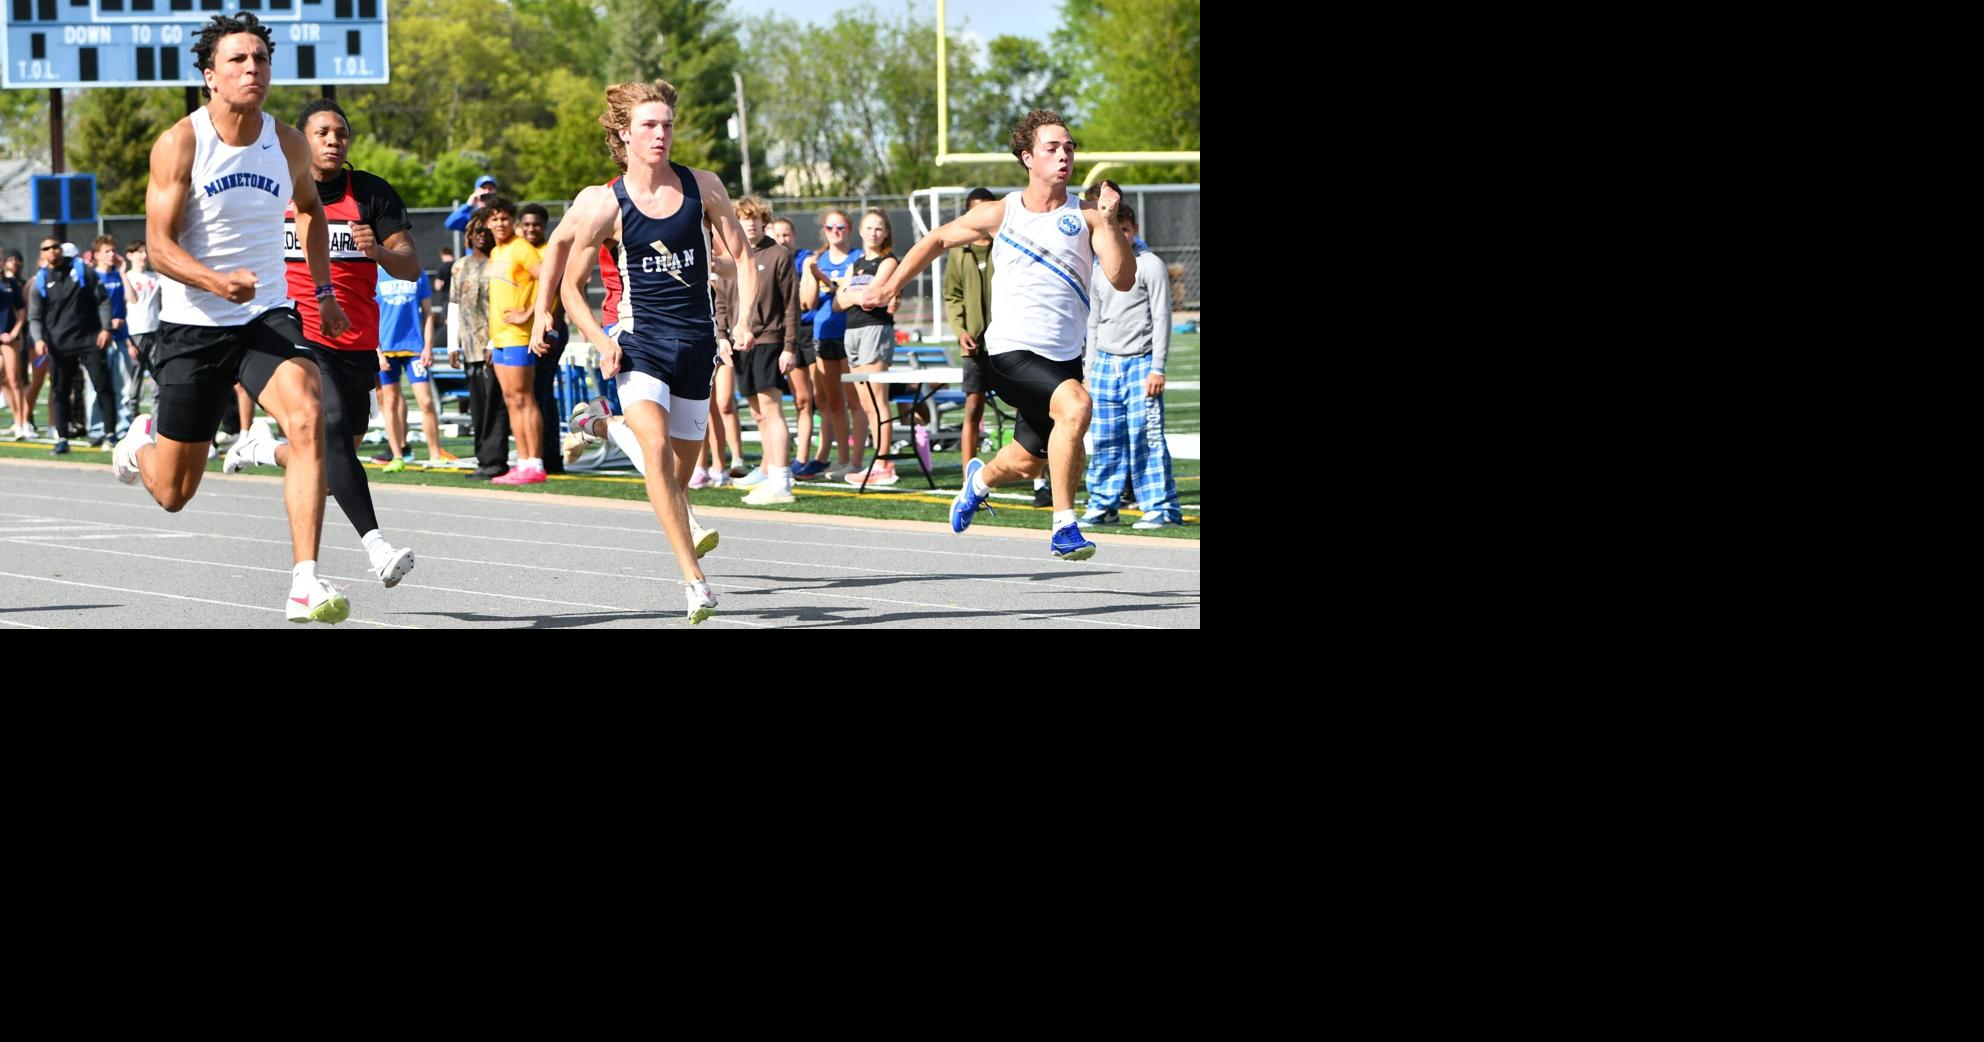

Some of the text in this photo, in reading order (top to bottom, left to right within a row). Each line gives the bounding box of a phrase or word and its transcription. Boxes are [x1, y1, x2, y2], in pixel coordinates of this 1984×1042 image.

[64, 25, 112, 45] DOWN
[131, 24, 183, 44] TO GO
[289, 23, 321, 42] QTR
[203, 172, 280, 197] MINNETONKA
[284, 230, 302, 250] DE
[642, 248, 695, 273] CHAN
